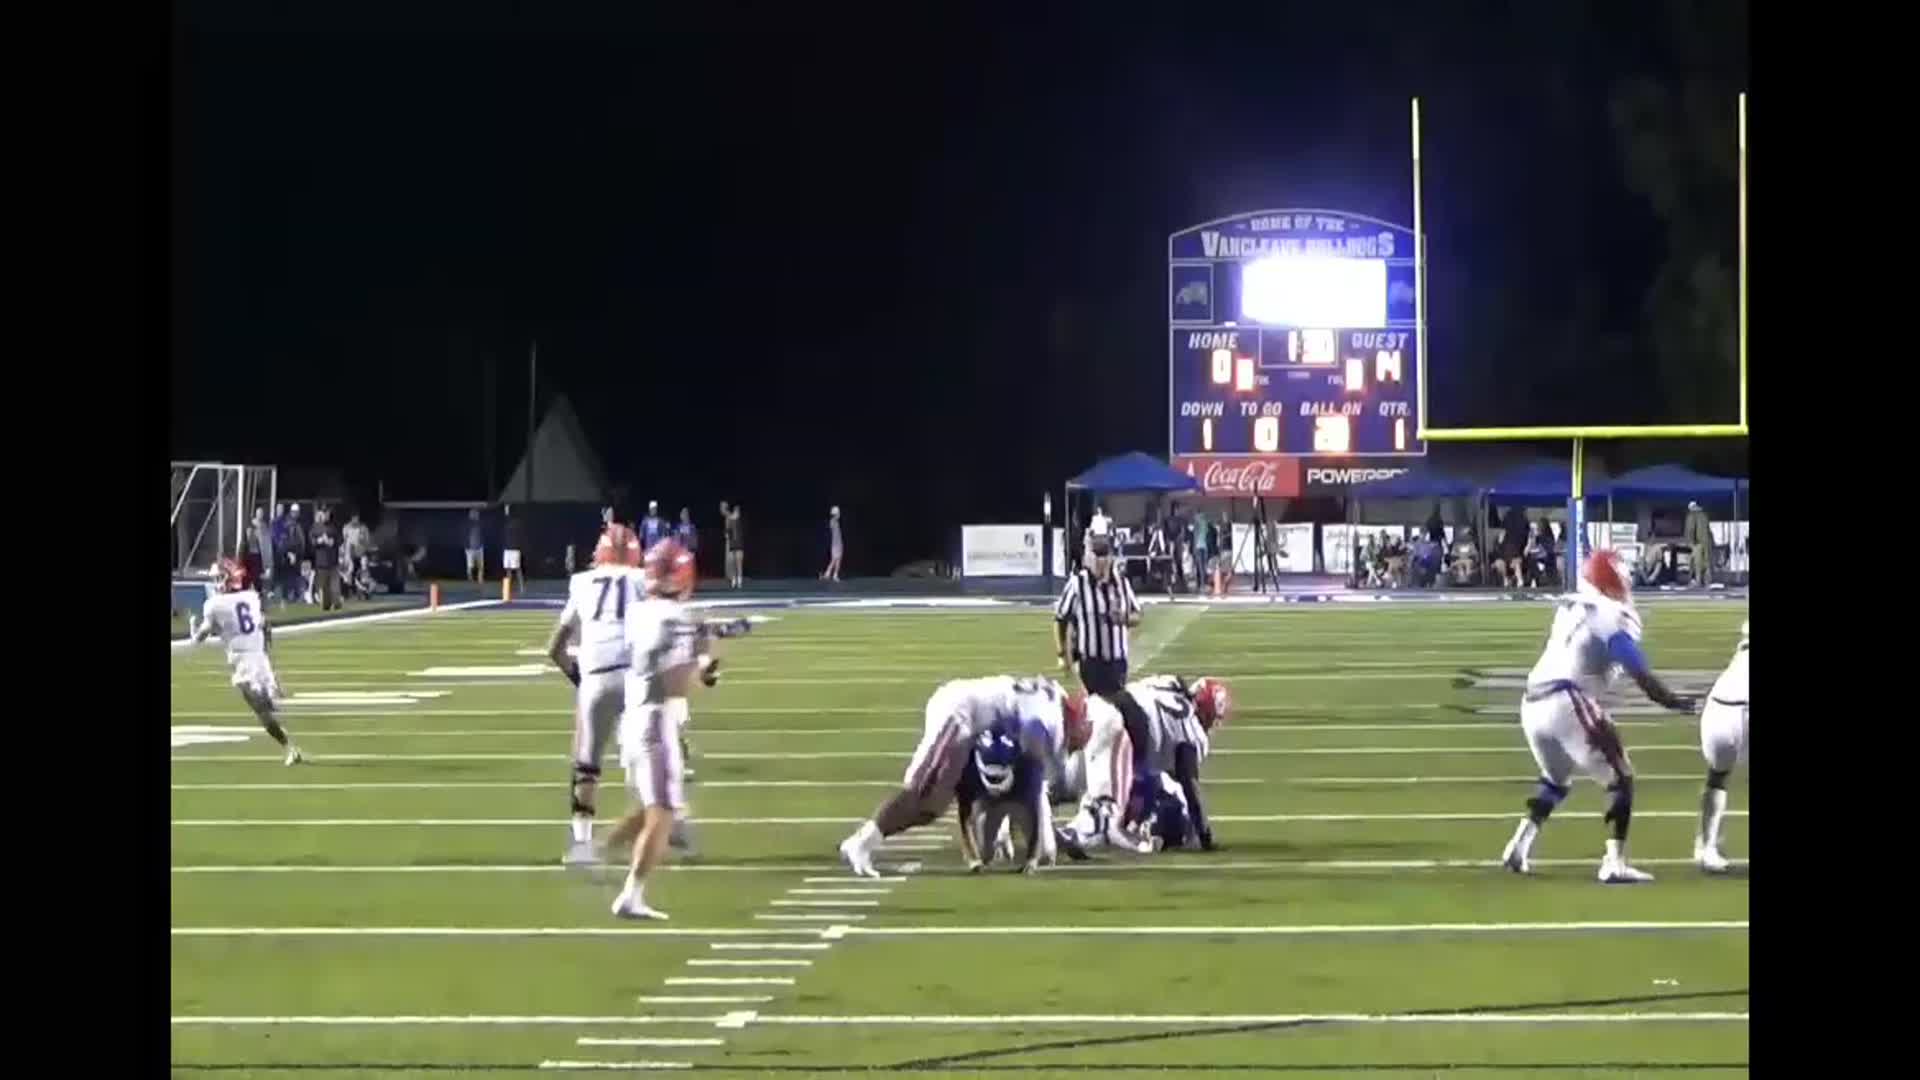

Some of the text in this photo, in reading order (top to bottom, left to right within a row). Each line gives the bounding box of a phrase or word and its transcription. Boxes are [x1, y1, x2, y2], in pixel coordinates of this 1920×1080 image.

[1315, 216, 1345, 232] THE
[1188, 332, 1239, 349] HOME
[1351, 332, 1409, 349] GUEST
[1181, 402, 1224, 416] DOWN
[1240, 402, 1282, 416] TO GO
[1300, 402, 1362, 416] BALL ON
[1203, 418, 1212, 451] 1
[1395, 418, 1405, 450] 1
[592, 576, 627, 620] 71
[236, 602, 255, 635] 6
